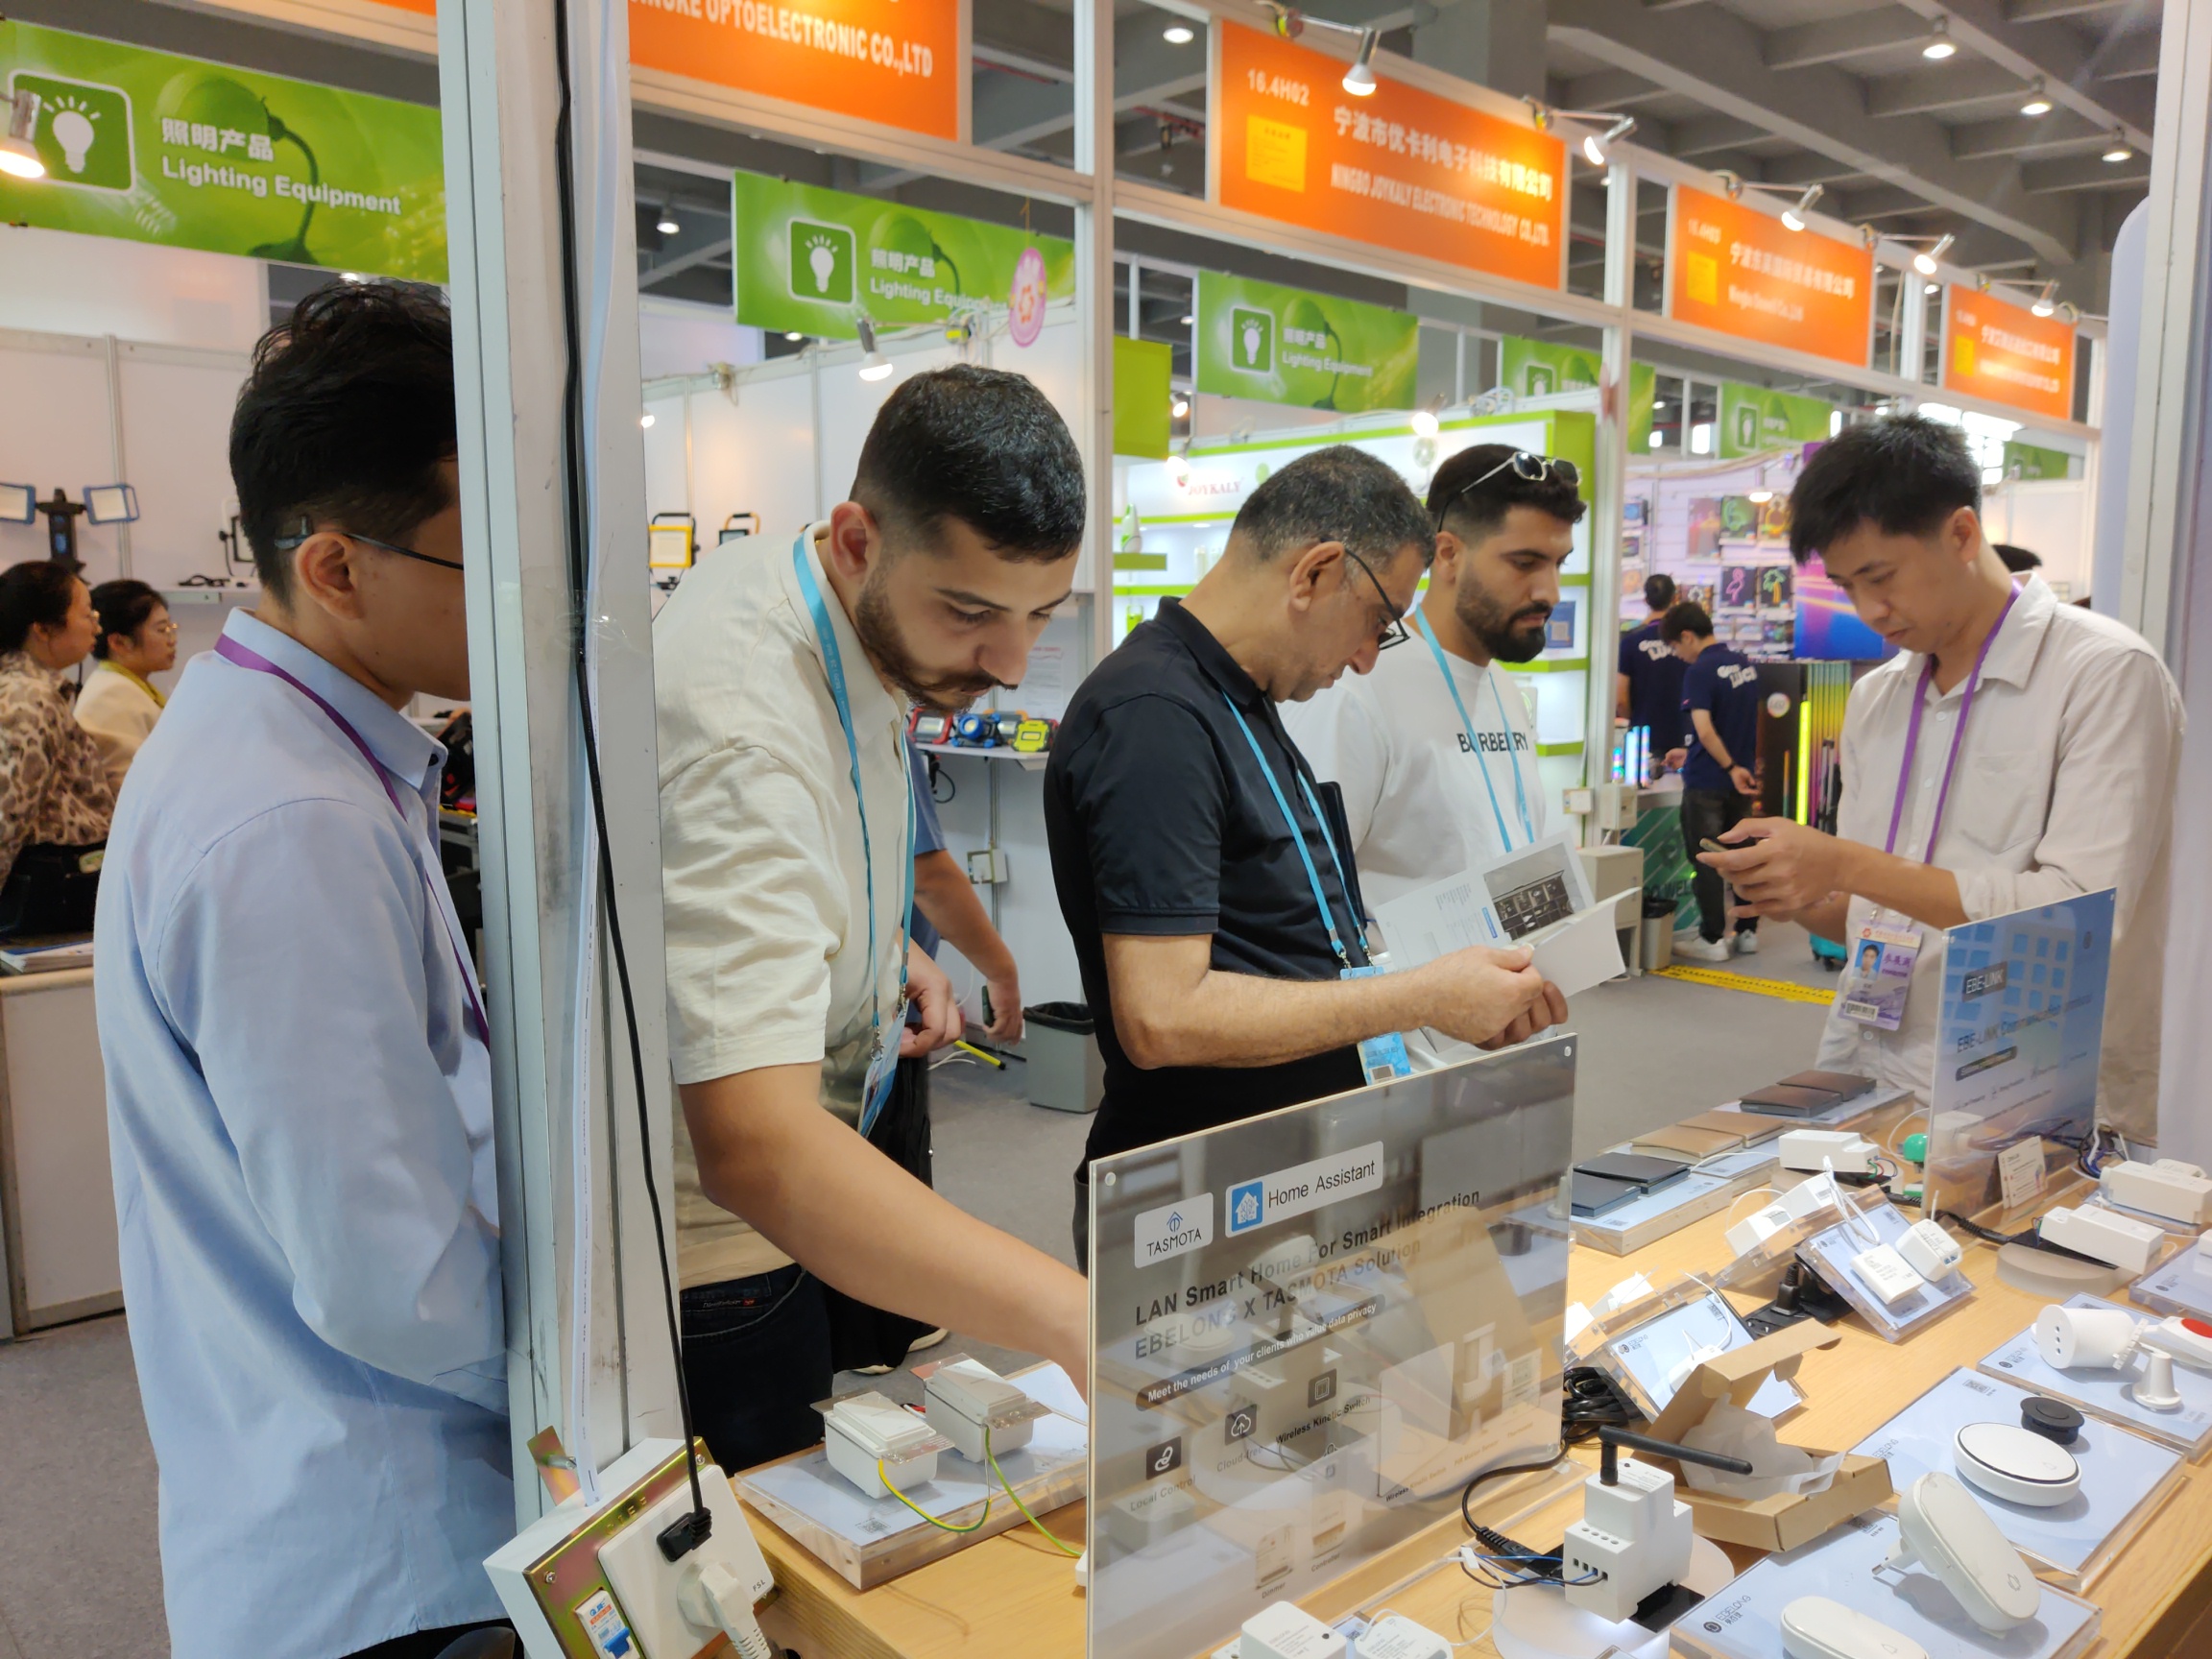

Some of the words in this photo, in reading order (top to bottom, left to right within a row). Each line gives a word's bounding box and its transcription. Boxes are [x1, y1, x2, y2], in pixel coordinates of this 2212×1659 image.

[705, 0, 868, 60] OPTOELECTRONIC
[870, 32, 933, 78] CO.,LTD
[1247, 68, 1310, 107] 16.4H02
[161, 117, 275, 162] 照明产品
[161, 156, 268, 198] Lighting
[274, 174, 402, 215] Equipment
[871, 248, 936, 278] 照明产品
[870, 276, 931, 306] Lighting
[1282, 349, 1323, 373] Lighting
[1323, 356, 1373, 377] Equipment
[1965, 969, 2005, 995] EBE-LINK
[1268, 1185, 1310, 1209] Home
[1315, 1160, 1376, 1194] Assistant
[1135, 1292, 1178, 1326] LAN
[1186, 1270, 1244, 1307] Smart
[1250, 1254, 1302, 1285] Home
[1342, 1219, 1391, 1250] Smart
[1397, 1190, 1480, 1231] Integration
[1146, 1228, 1203, 1258] TASMOTA
[1135, 1305, 1237, 1360] EBELONG
[1243, 1297, 1256, 1319] X
[1262, 1263, 1349, 1311] TASMOTA
[1354, 1238, 1421, 1275] Solution
[1147, 1387, 1169, 1404] Meet
[1173, 1378, 1189, 1392] the
[1190, 1366, 1218, 1385] needs
[1220, 1359, 1231, 1373] of
[1234, 1352, 1255, 1370] your
[1256, 1340, 1285, 1358] clients
[1286, 1331, 1305, 1346] who
[1305, 1322, 1327, 1338] value
[1328, 1313, 1346, 1328] data
[1347, 1302, 1378, 1324] privacy
[1275, 1423, 1311, 1444] Wireless
[1312, 1408, 1343, 1429] Kinetic
[1343, 1396, 1372, 1415] Switch
[1130, 1491, 1158, 1512] Local
[1160, 1474, 1196, 1499] Control
[752, 1578, 766, 1593] FSL
[1716, 1595, 1752, 1622] EBELONG
